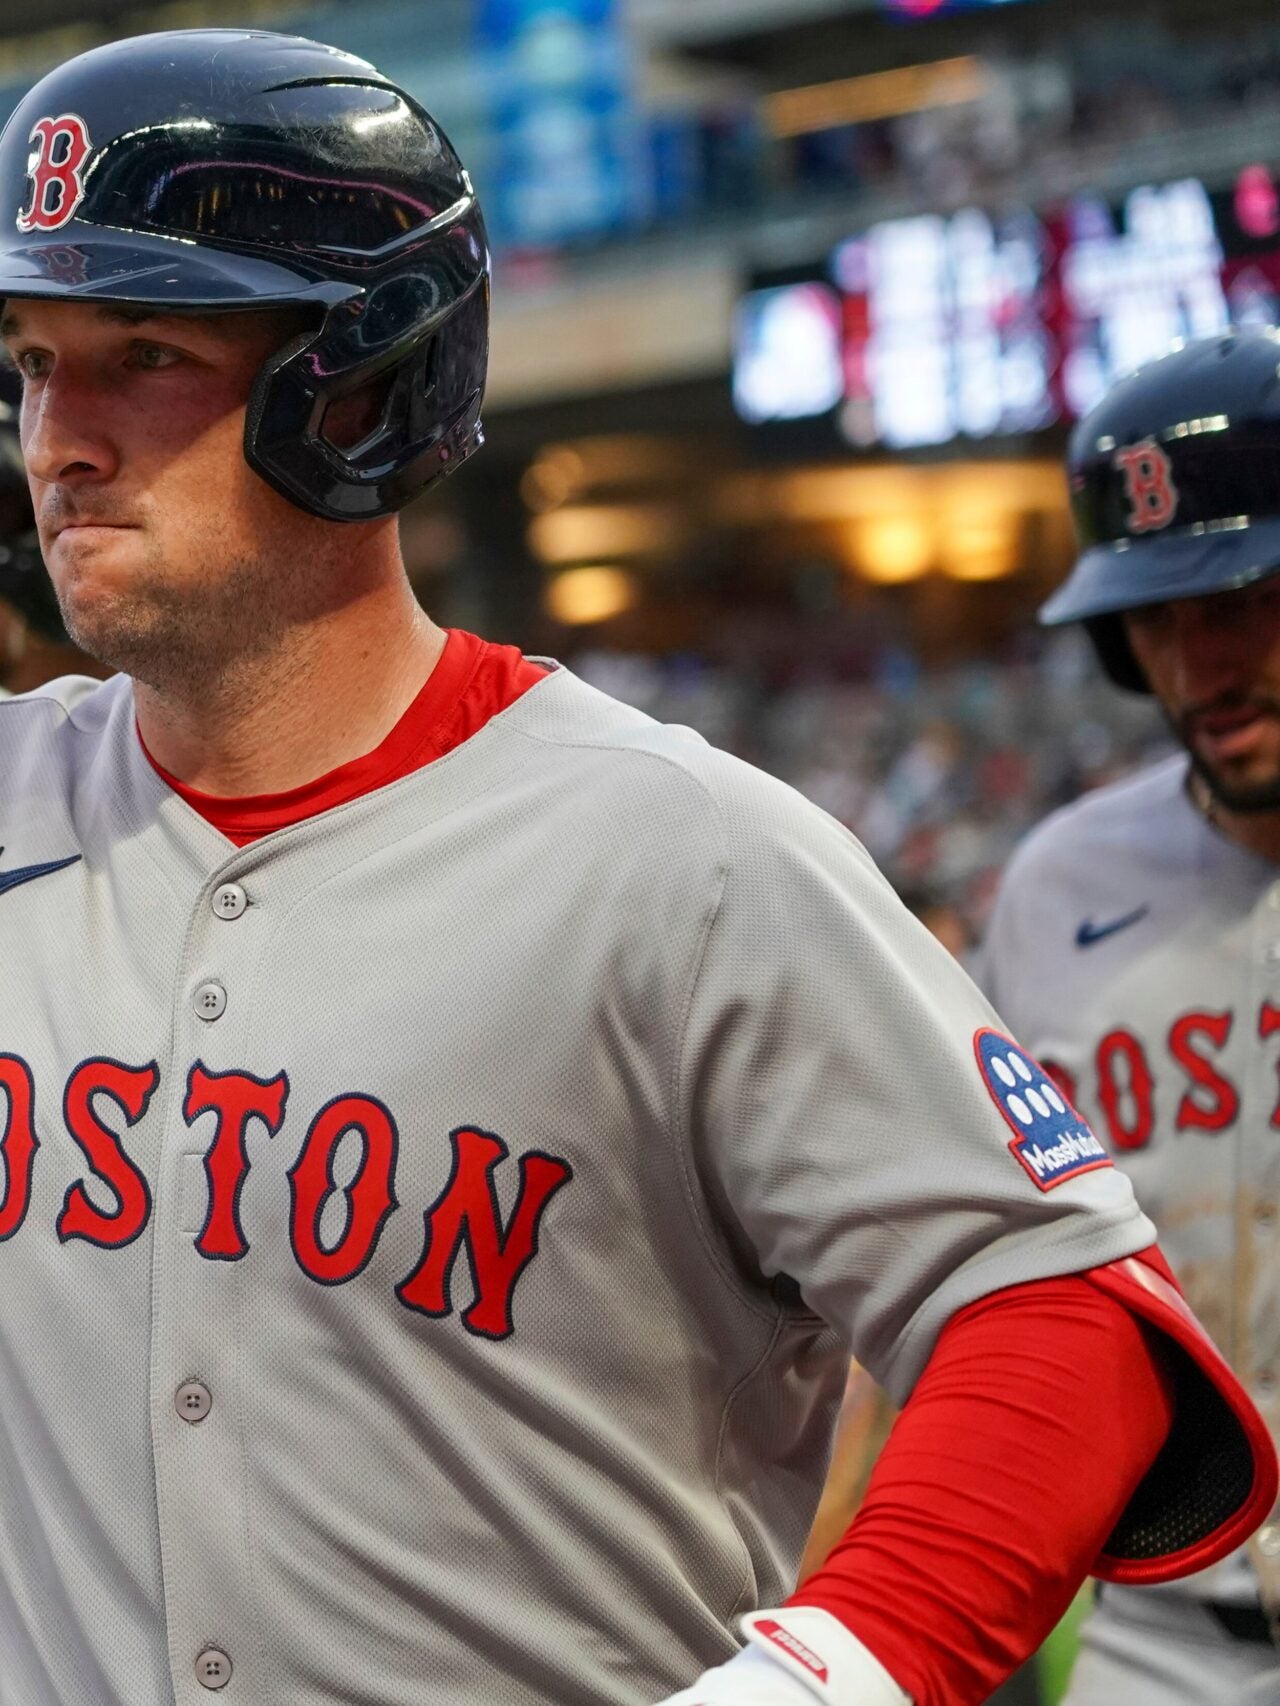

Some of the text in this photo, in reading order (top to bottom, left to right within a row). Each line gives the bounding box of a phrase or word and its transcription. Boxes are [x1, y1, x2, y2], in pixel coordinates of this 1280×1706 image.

[16, 114, 93, 233] B
[1115, 440, 1177, 533] B
[1021, 1126, 1106, 1177] MassMut
